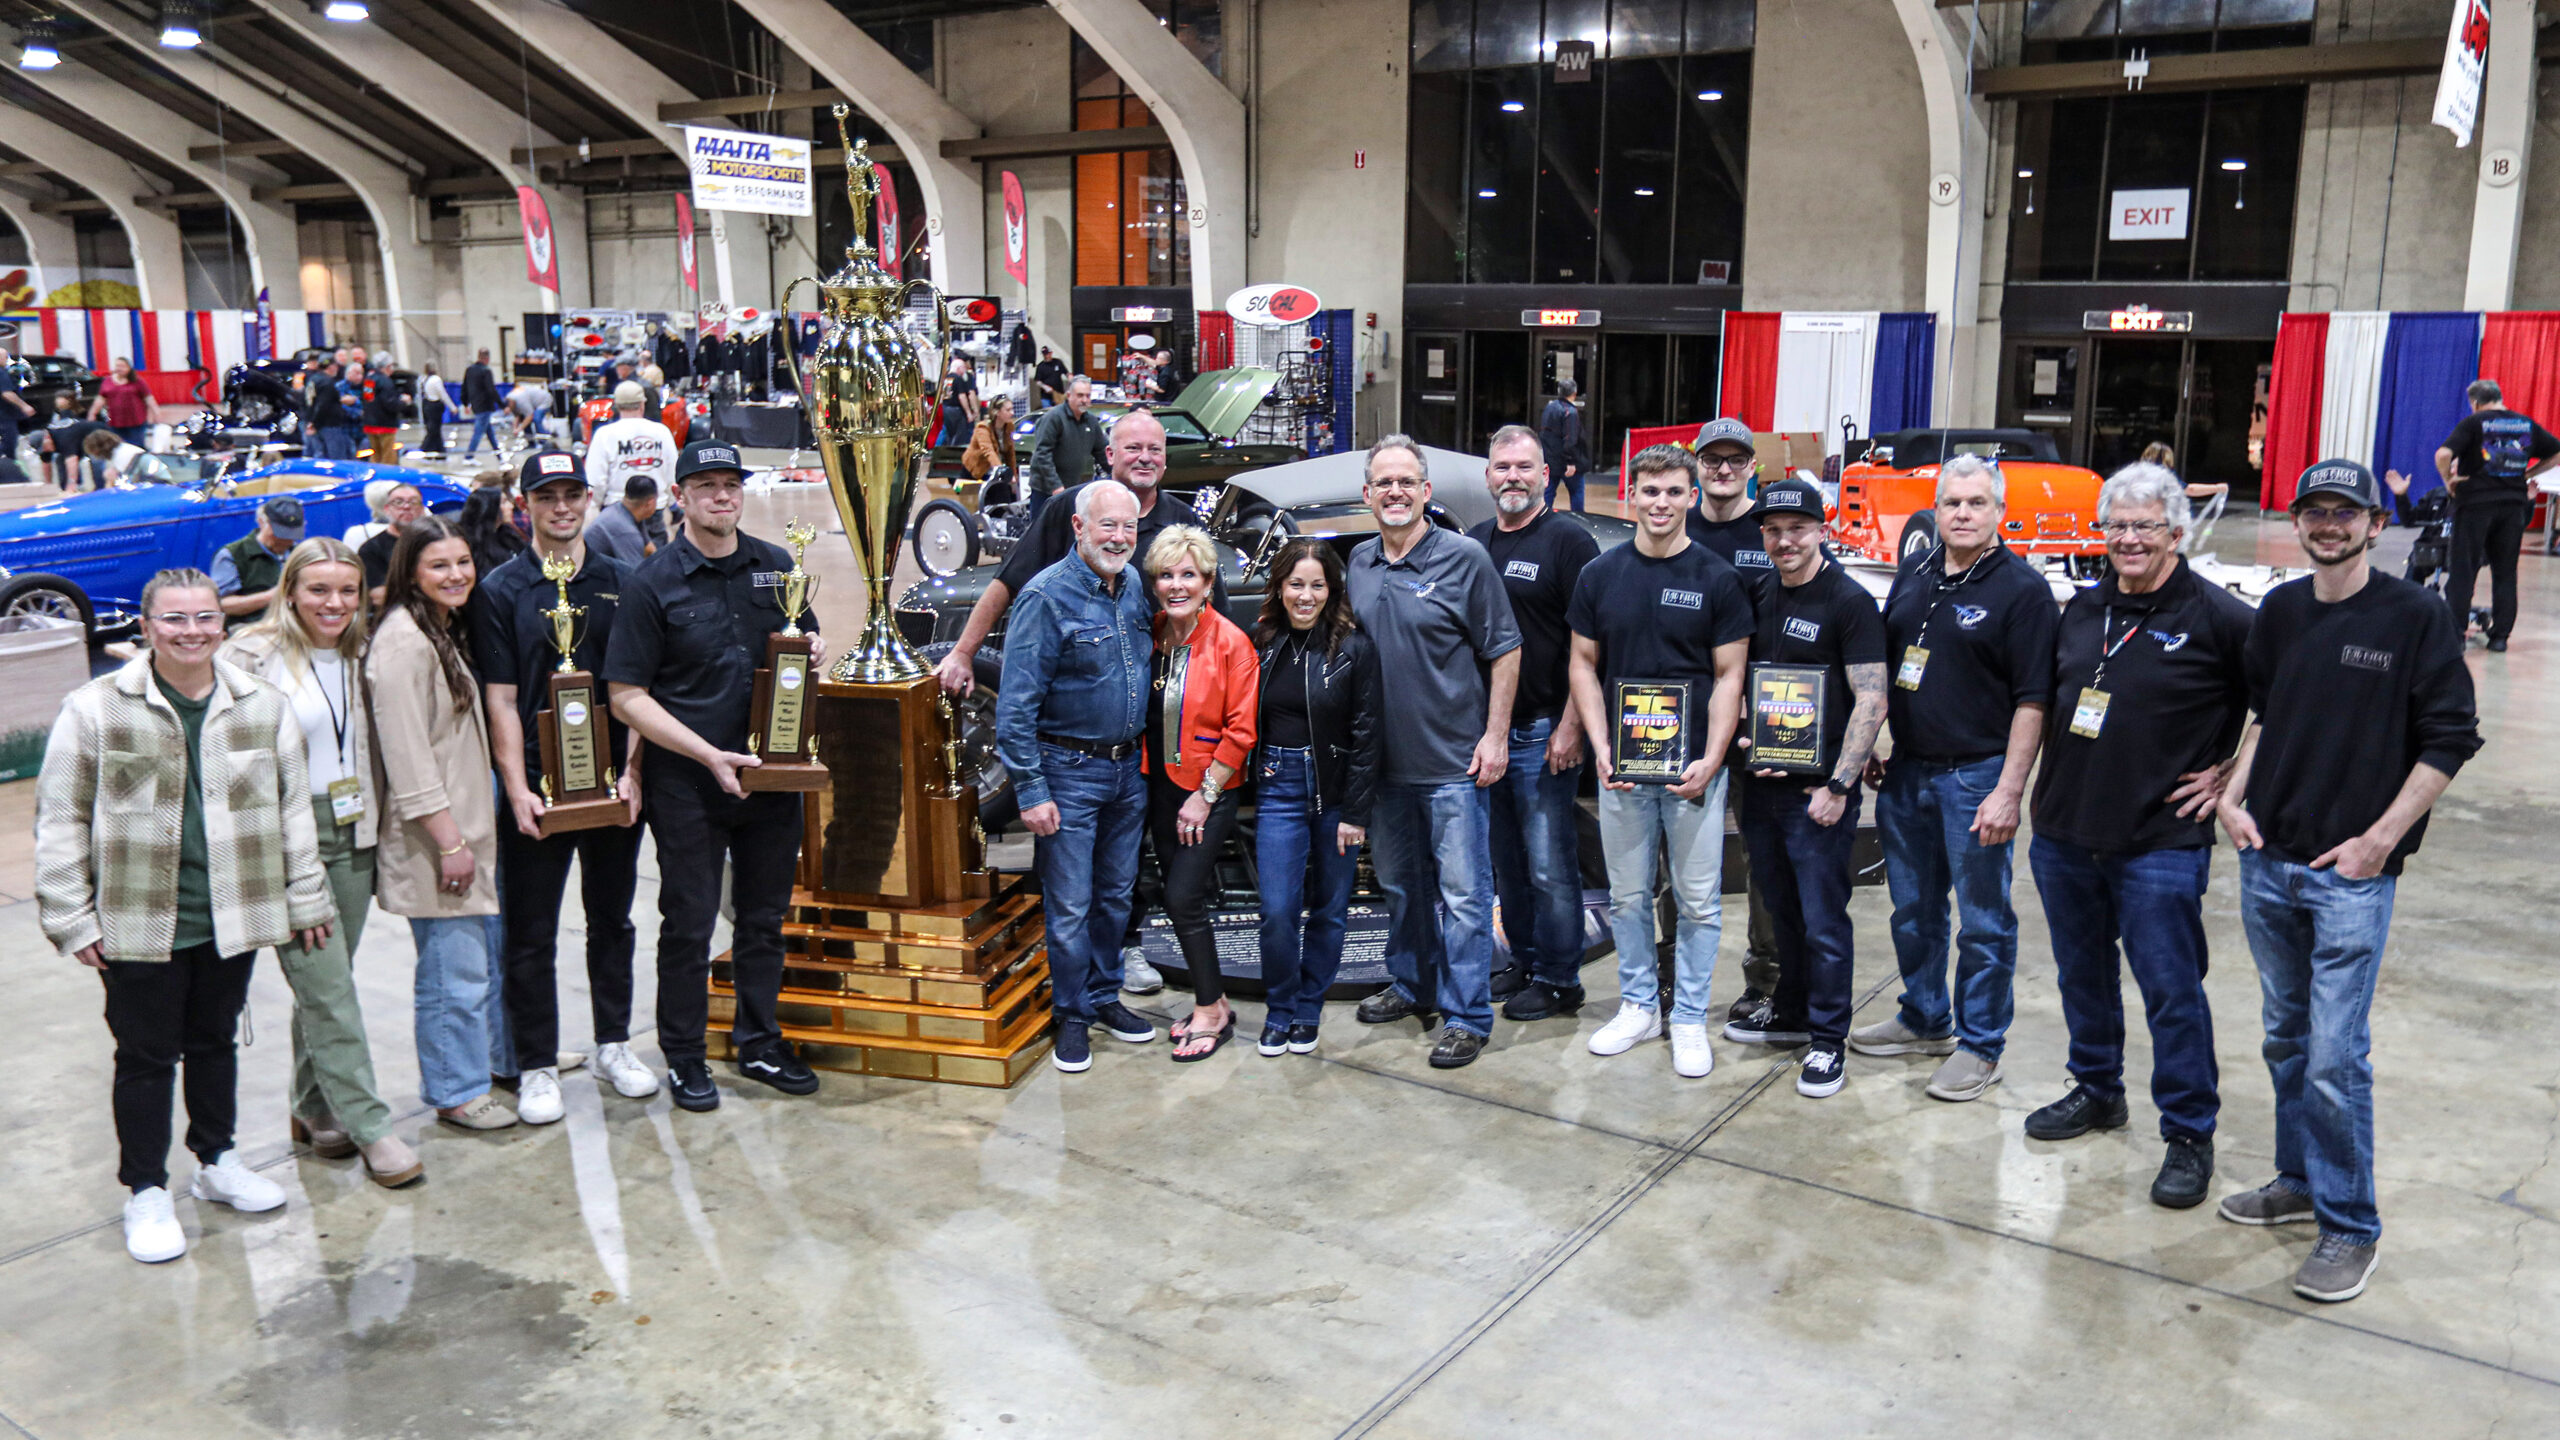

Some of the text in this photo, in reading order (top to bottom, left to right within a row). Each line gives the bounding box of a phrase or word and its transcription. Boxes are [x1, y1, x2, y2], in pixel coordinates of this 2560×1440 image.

[1556, 51, 1590, 71] 4W
[694, 135, 771, 162] MAITA
[711, 160, 805, 183] MOTORSPORTS
[2492, 159, 2510, 176] 18
[734, 185, 805, 201] PERFORMANCE
[1938, 181, 1951, 196] 19
[1191, 208, 1204, 221] 20
[2123, 207, 2175, 226] EXIT
[1540, 309, 1580, 326] EXIT
[2110, 311, 2164, 331] EXIT
[618, 440, 662, 455] MOON
[1761, 681, 1816, 729] 75
[1625, 694, 1680, 741] 75
